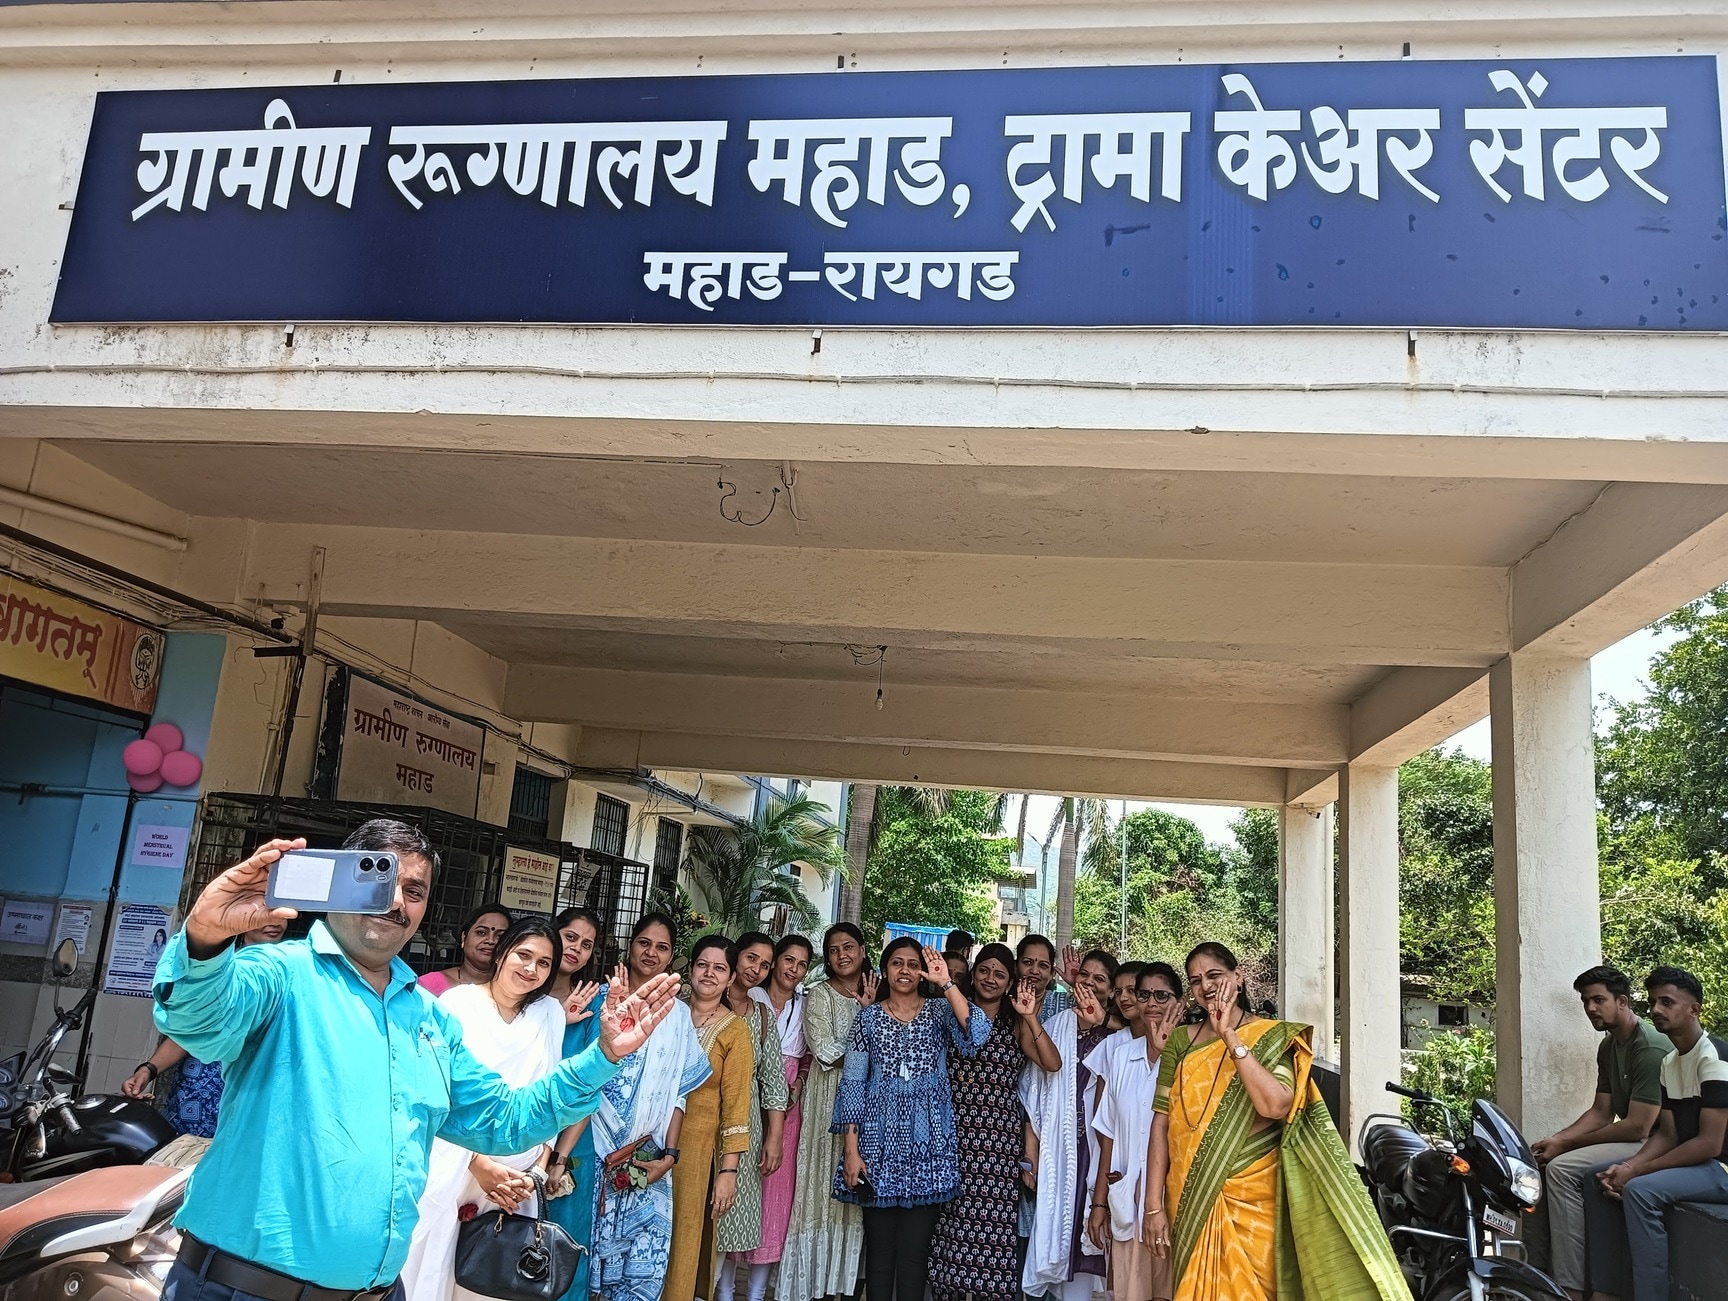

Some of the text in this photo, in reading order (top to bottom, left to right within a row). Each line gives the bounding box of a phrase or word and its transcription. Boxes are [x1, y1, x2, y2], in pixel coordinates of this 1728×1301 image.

[132, 99, 371, 221] ग्रामीण
[748, 117, 971, 228] महाड,
[1005, 112, 1190, 232] ट्रामा
[1213, 73, 1440, 204] केअर
[1465, 69, 1668, 205] सेंटर
[354, 707, 409, 748] ग्रामीण
[396, 763, 434, 794] महाड
